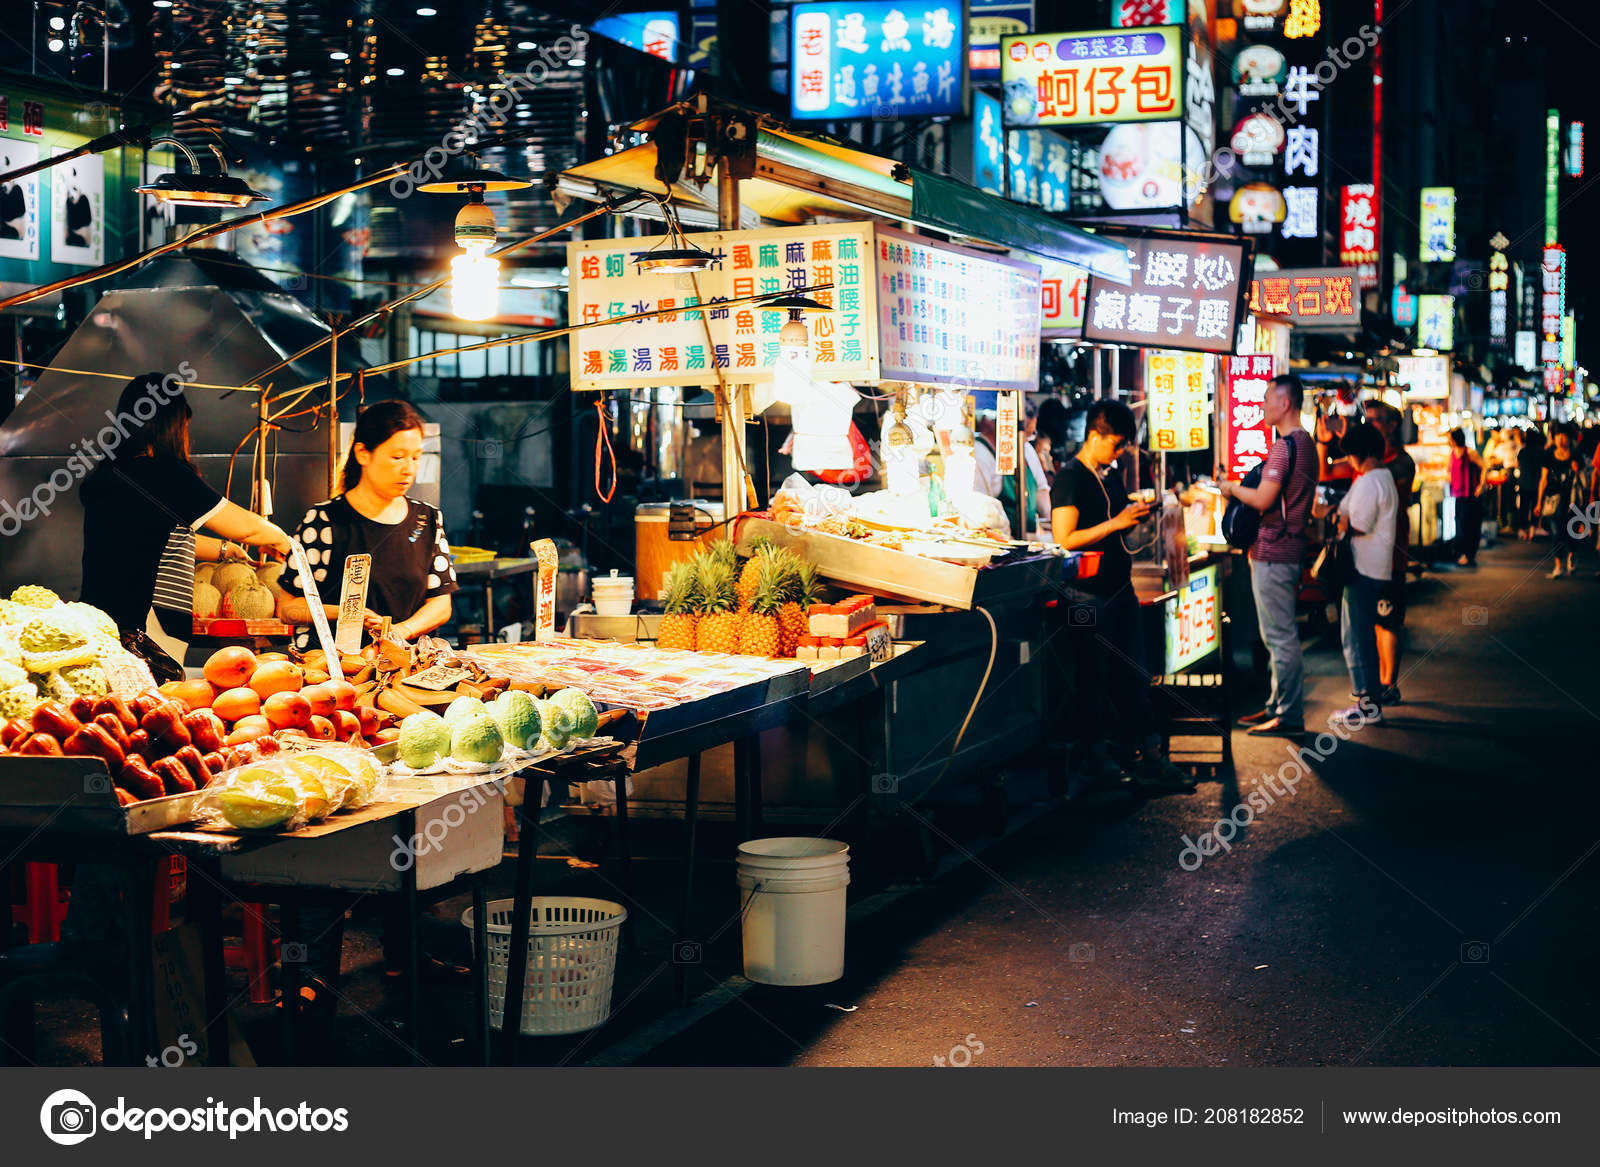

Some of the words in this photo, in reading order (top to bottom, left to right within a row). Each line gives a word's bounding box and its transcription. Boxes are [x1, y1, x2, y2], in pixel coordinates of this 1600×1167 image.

[1037, 64, 1175, 118] 蚵仔包
[1071, 35, 1148, 56] 布袋名產
[1281, 66, 1319, 239] 牛肉麵
[581, 255, 603, 375] 蛤仔湯
[605, 254, 628, 373] 蚵仔湯
[732, 244, 756, 368] 虱目魚湯
[838, 238, 862, 362] 麻油腰子湯
